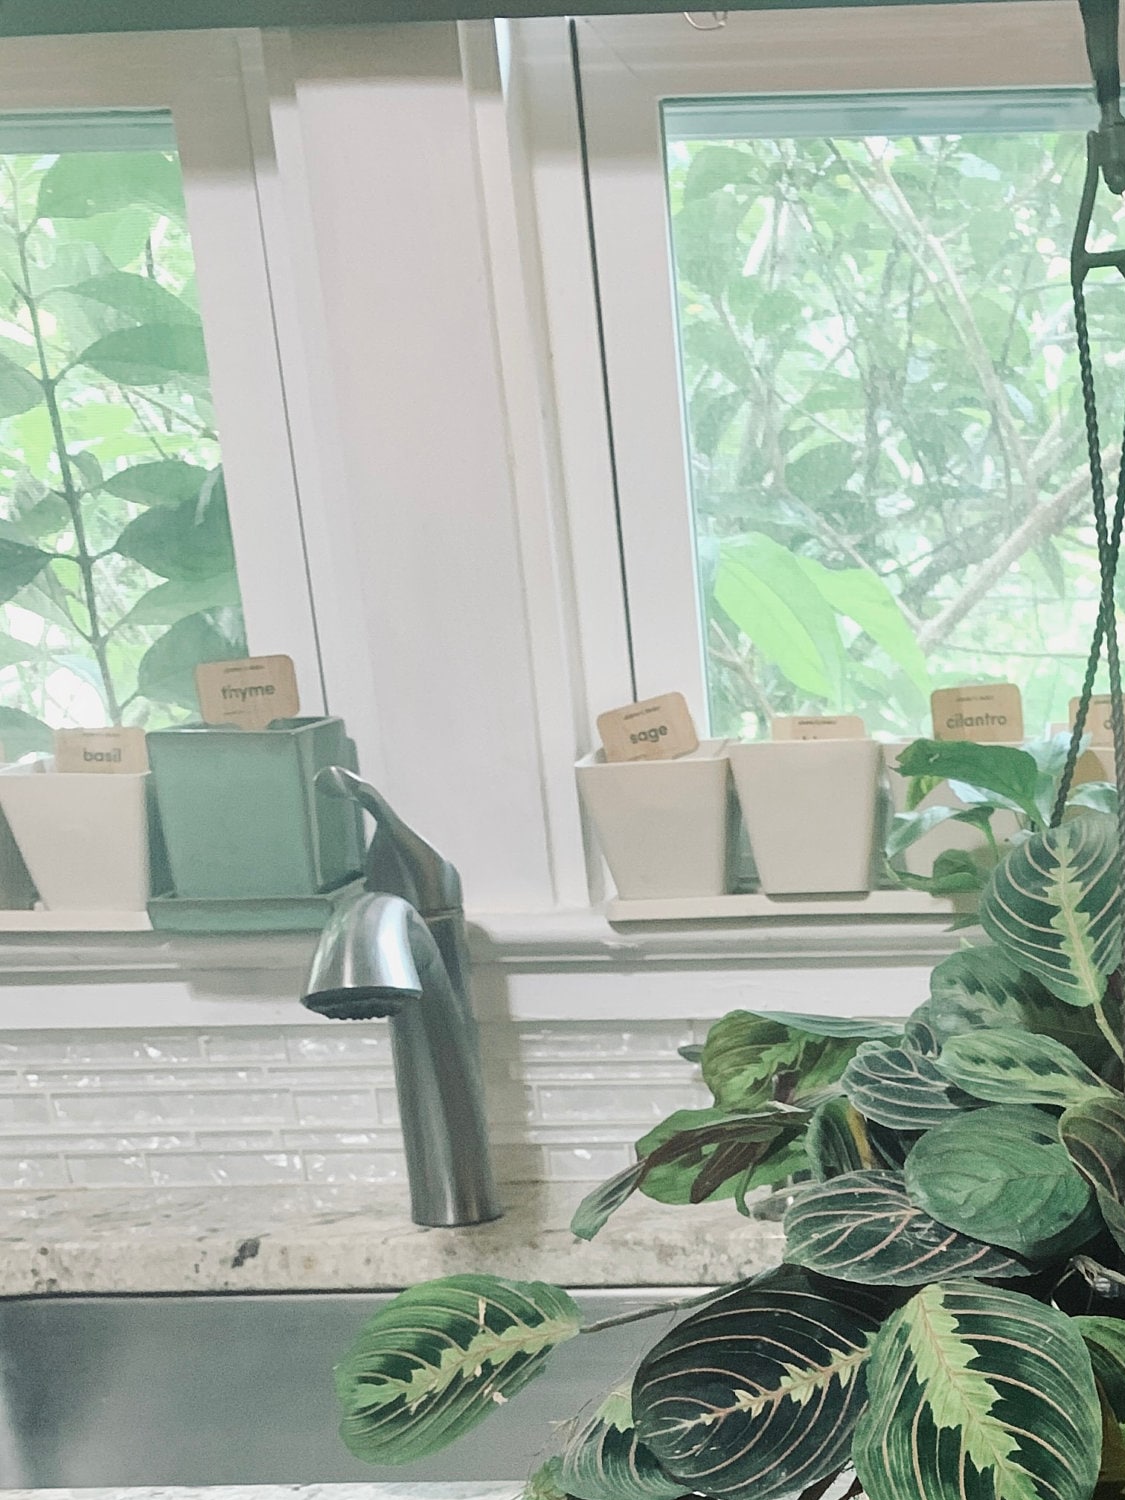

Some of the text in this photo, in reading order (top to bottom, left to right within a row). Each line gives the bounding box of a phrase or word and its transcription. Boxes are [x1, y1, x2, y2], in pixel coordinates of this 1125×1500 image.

[221, 684, 276, 702] thyme
[946, 712, 1007, 729] cilantro
[630, 725, 668, 744] sage
[83, 748, 121, 762] basil
